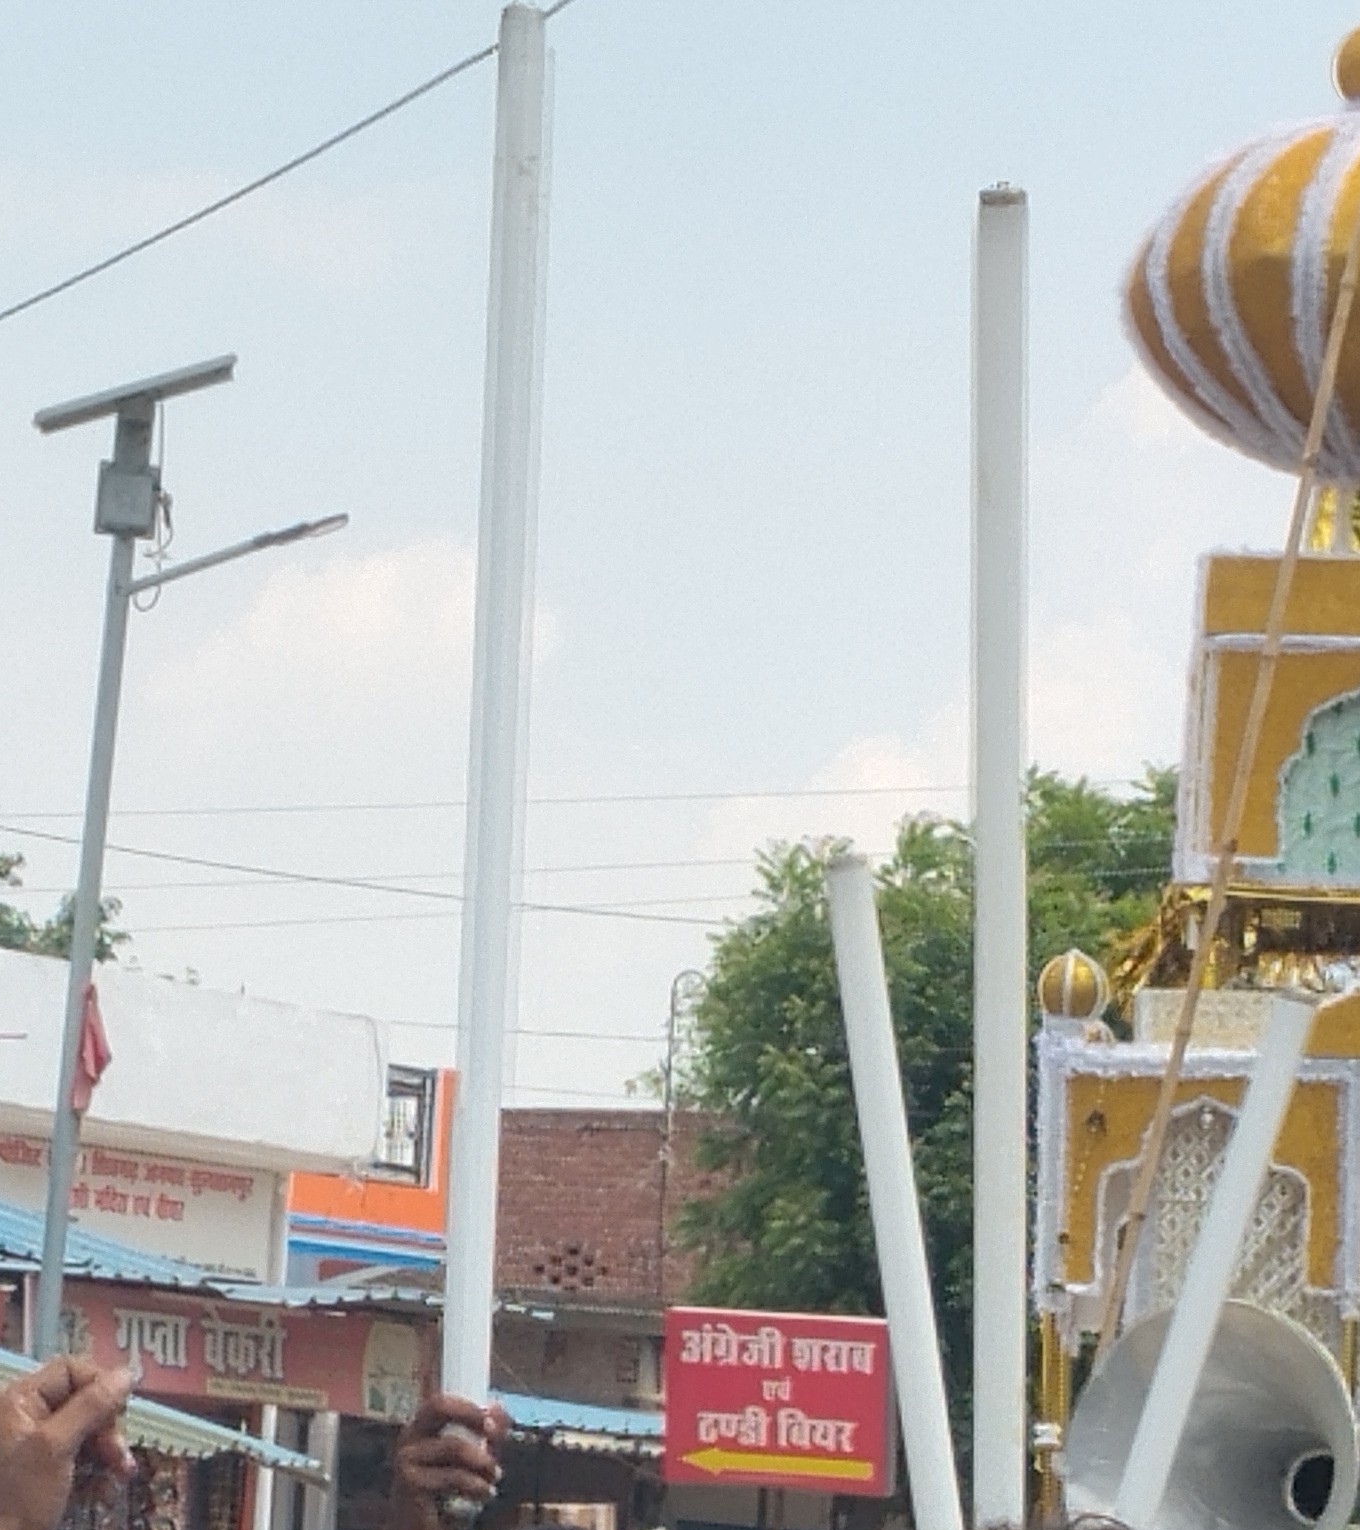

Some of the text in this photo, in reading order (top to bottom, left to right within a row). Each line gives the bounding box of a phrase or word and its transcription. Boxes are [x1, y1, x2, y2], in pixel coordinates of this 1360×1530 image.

[114, 1308, 190, 1386] गुप्ता
[680, 1323, 876, 1374] अंग्रेजी शराब
[762, 1376, 791, 1402] एवं
[697, 1405, 859, 1454] ठण्डी बियर
